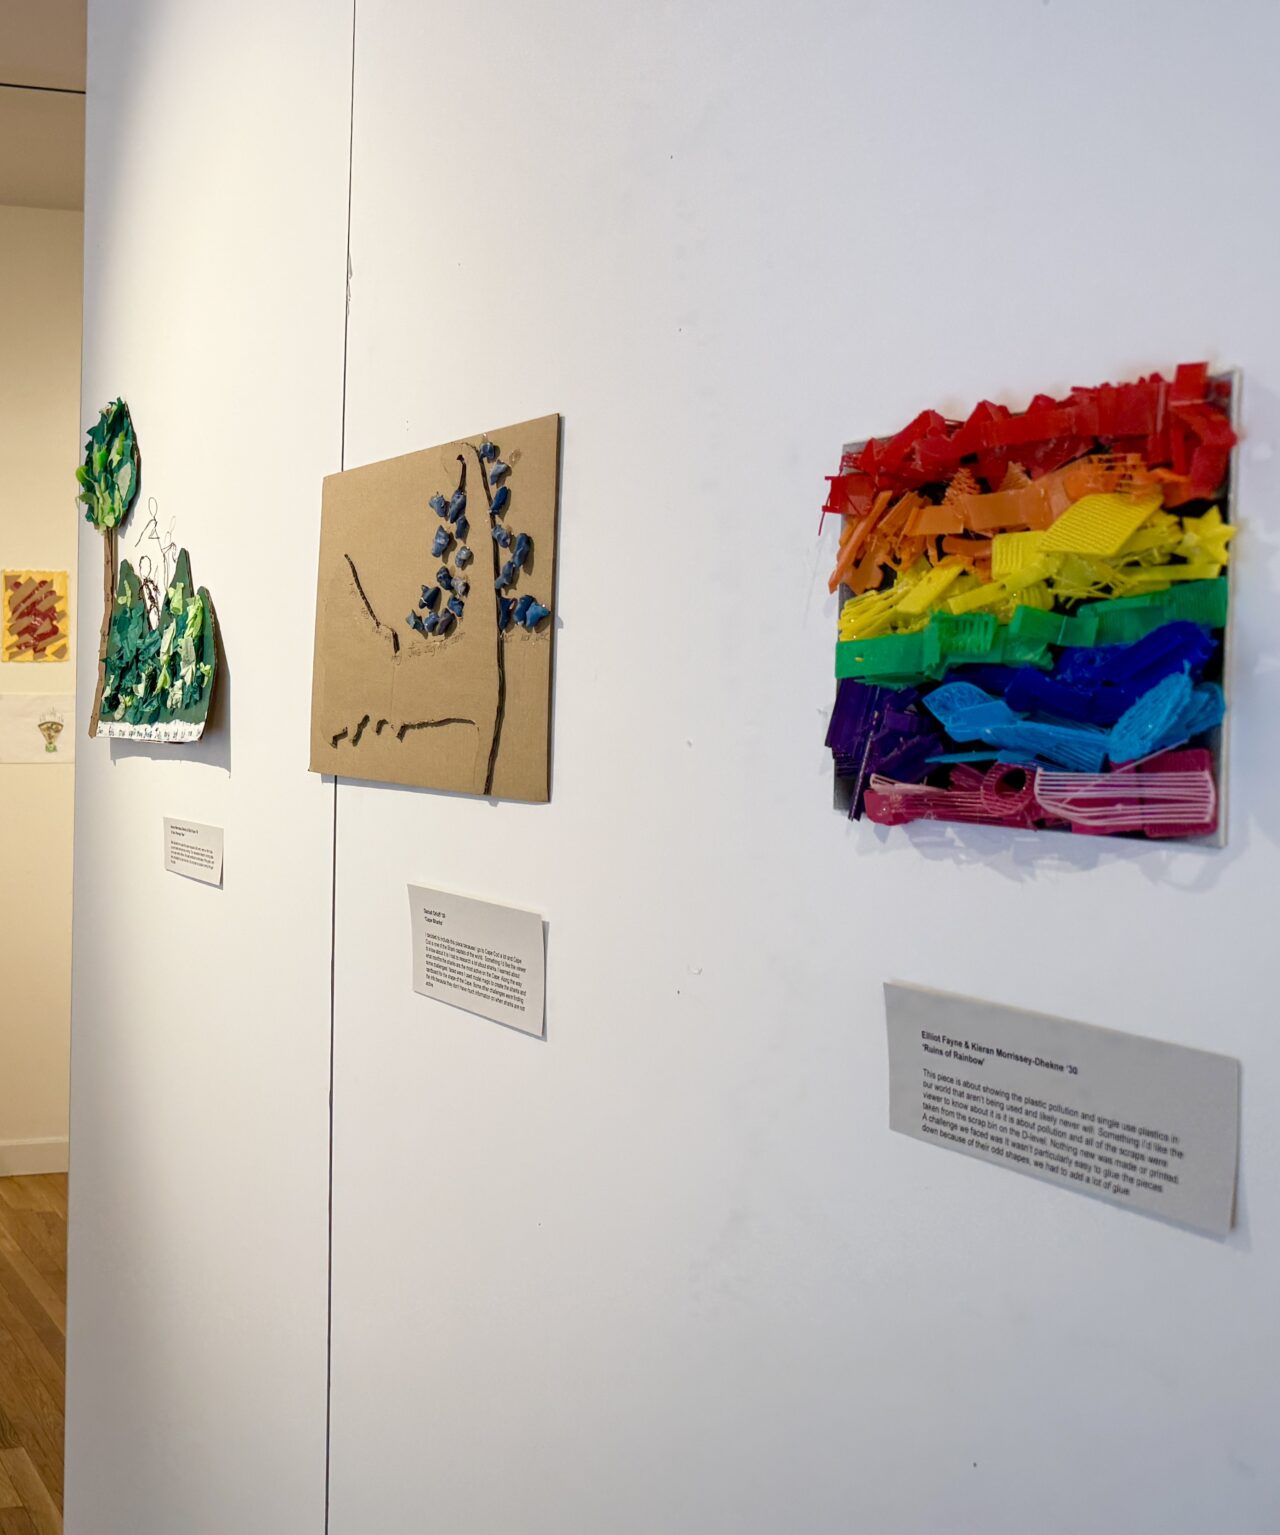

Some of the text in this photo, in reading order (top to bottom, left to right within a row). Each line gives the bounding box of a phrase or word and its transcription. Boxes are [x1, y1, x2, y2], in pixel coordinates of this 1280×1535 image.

[942, 1035, 963, 1048] Fayne
[964, 1041, 970, 1049] &
[971, 1042, 994, 1055] Kieran
[945, 1049, 952, 1058] of
